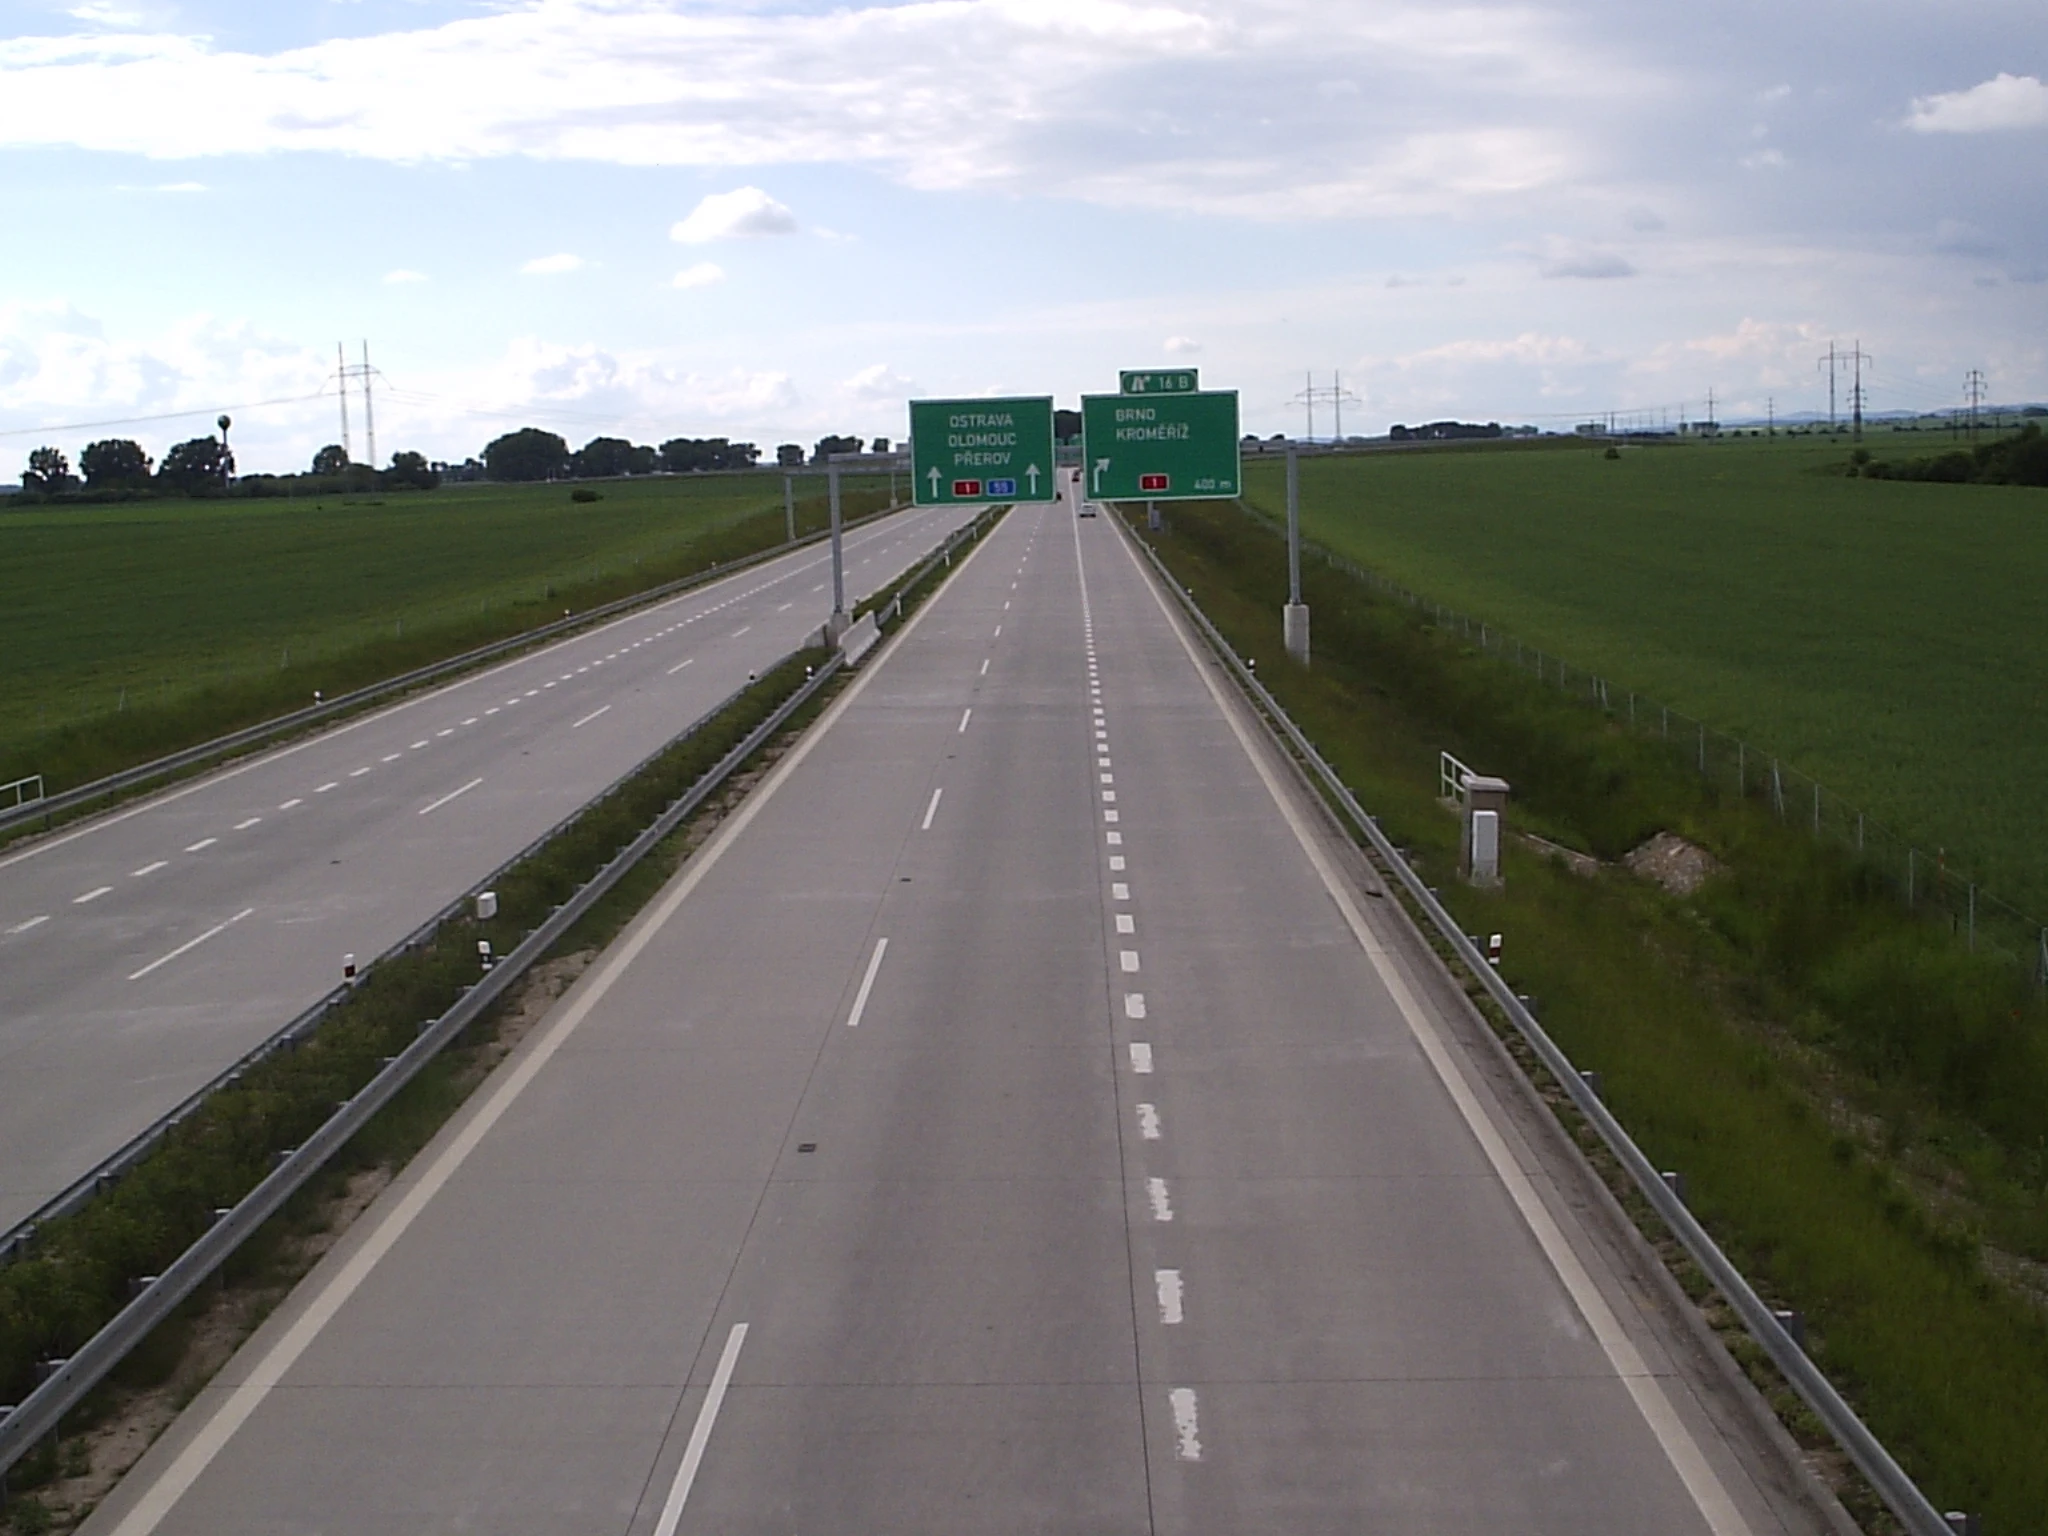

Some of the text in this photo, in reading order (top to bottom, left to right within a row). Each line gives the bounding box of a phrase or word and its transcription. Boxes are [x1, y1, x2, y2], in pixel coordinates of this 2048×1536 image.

[1160, 376, 1189, 390] 16 B
[950, 414, 1013, 428] OSTRAVA
[1115, 408, 1156, 422] BRNO
[1116, 423, 1190, 441] KROMĚŘÍŽ
[948, 432, 1017, 448] OLOMOUC
[954, 450, 1012, 466] PŘEROV
